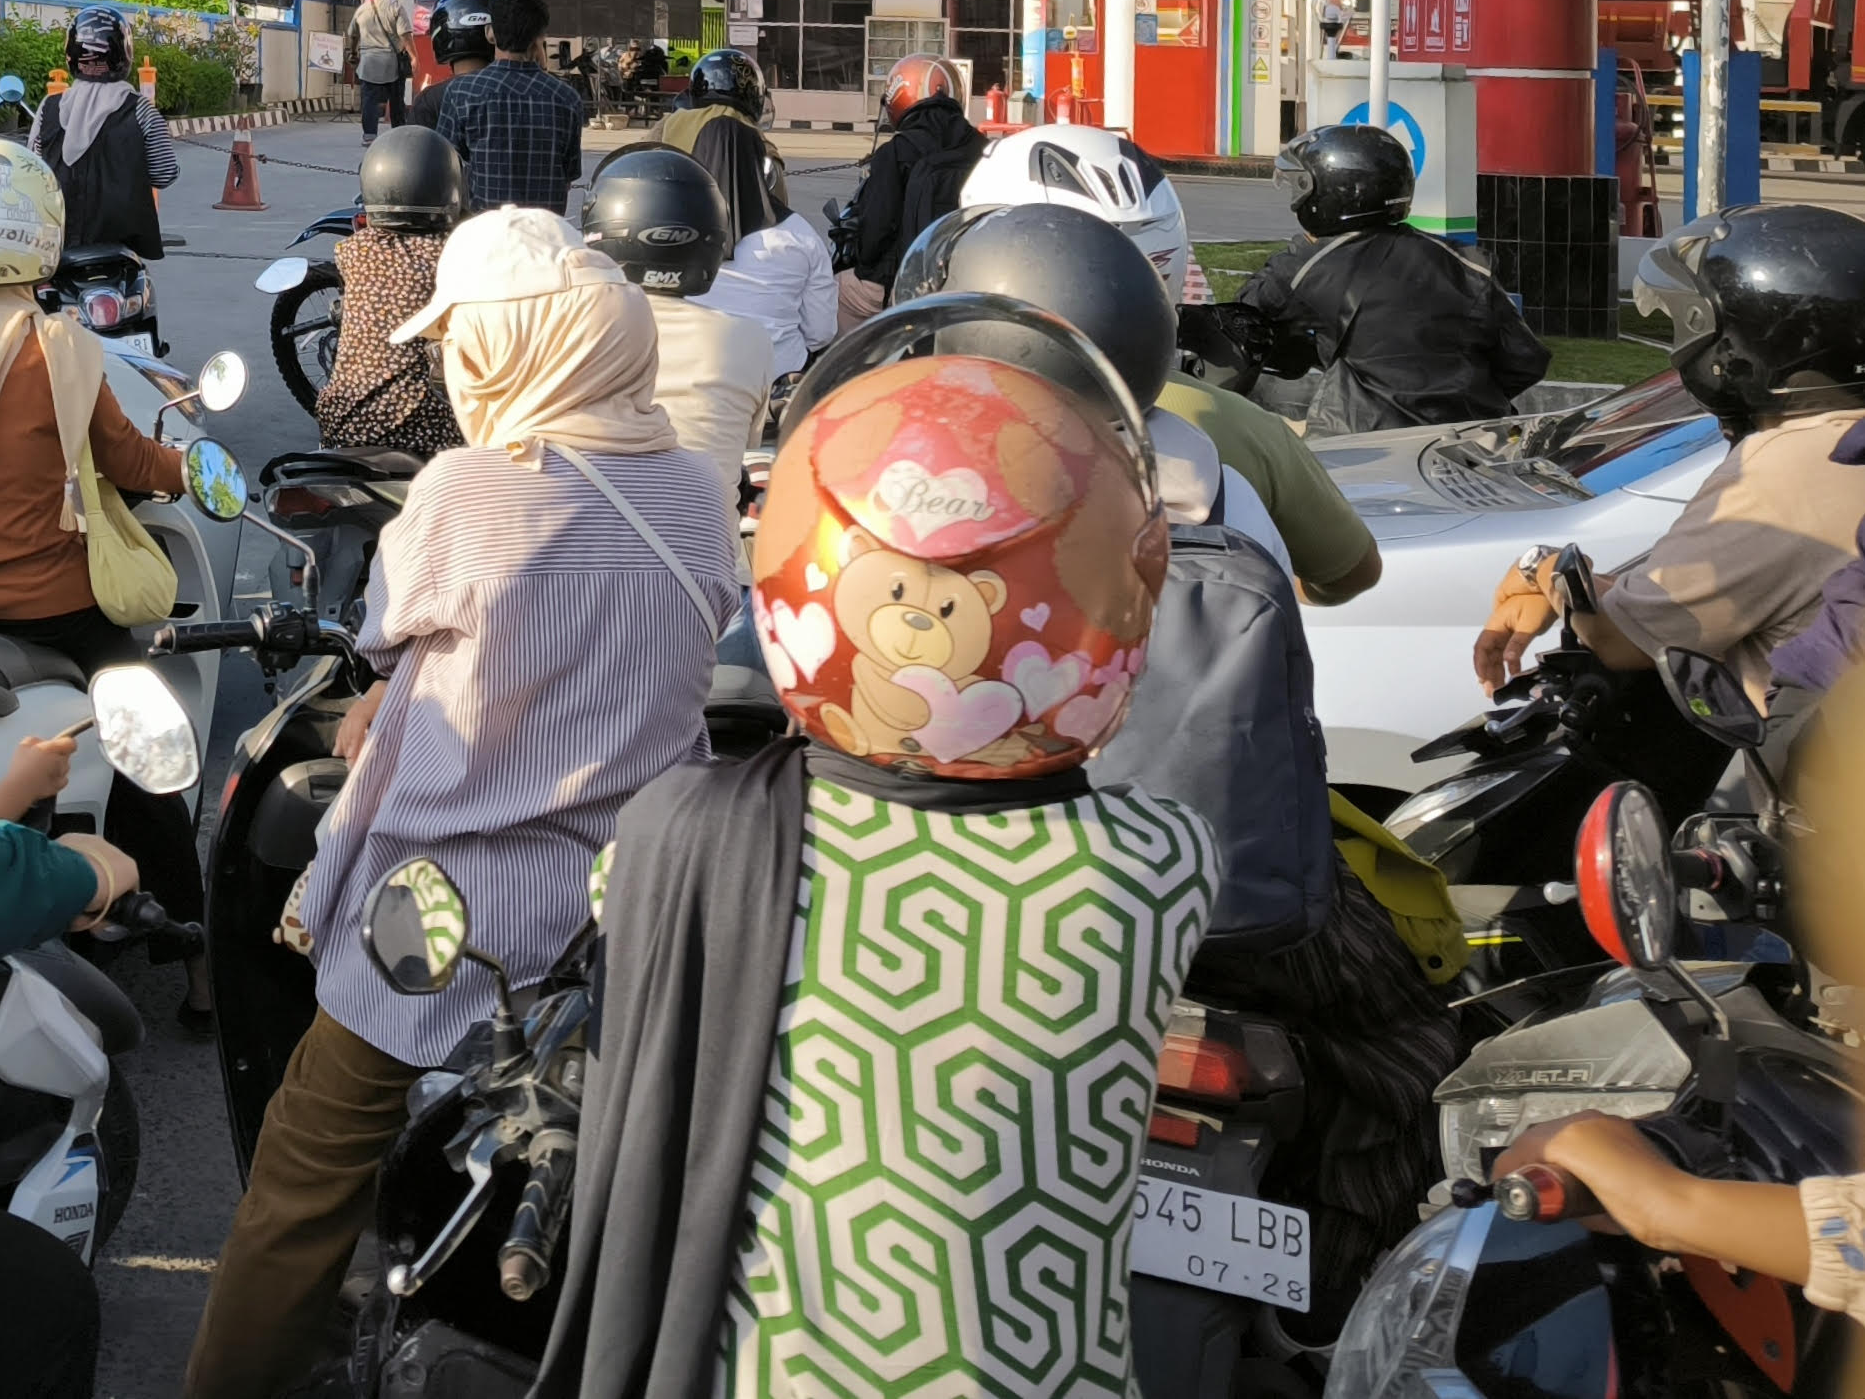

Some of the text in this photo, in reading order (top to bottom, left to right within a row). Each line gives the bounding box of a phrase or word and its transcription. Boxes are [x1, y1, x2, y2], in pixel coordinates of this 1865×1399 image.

[651, 229, 690, 242] GM
[643, 269, 683, 285] GMX
[898, 477, 986, 513] Bear
[1140, 1157, 1201, 1178] HONDA
[54, 1202, 95, 1224] HONDA
[1231, 1201, 1303, 1257] LBB
